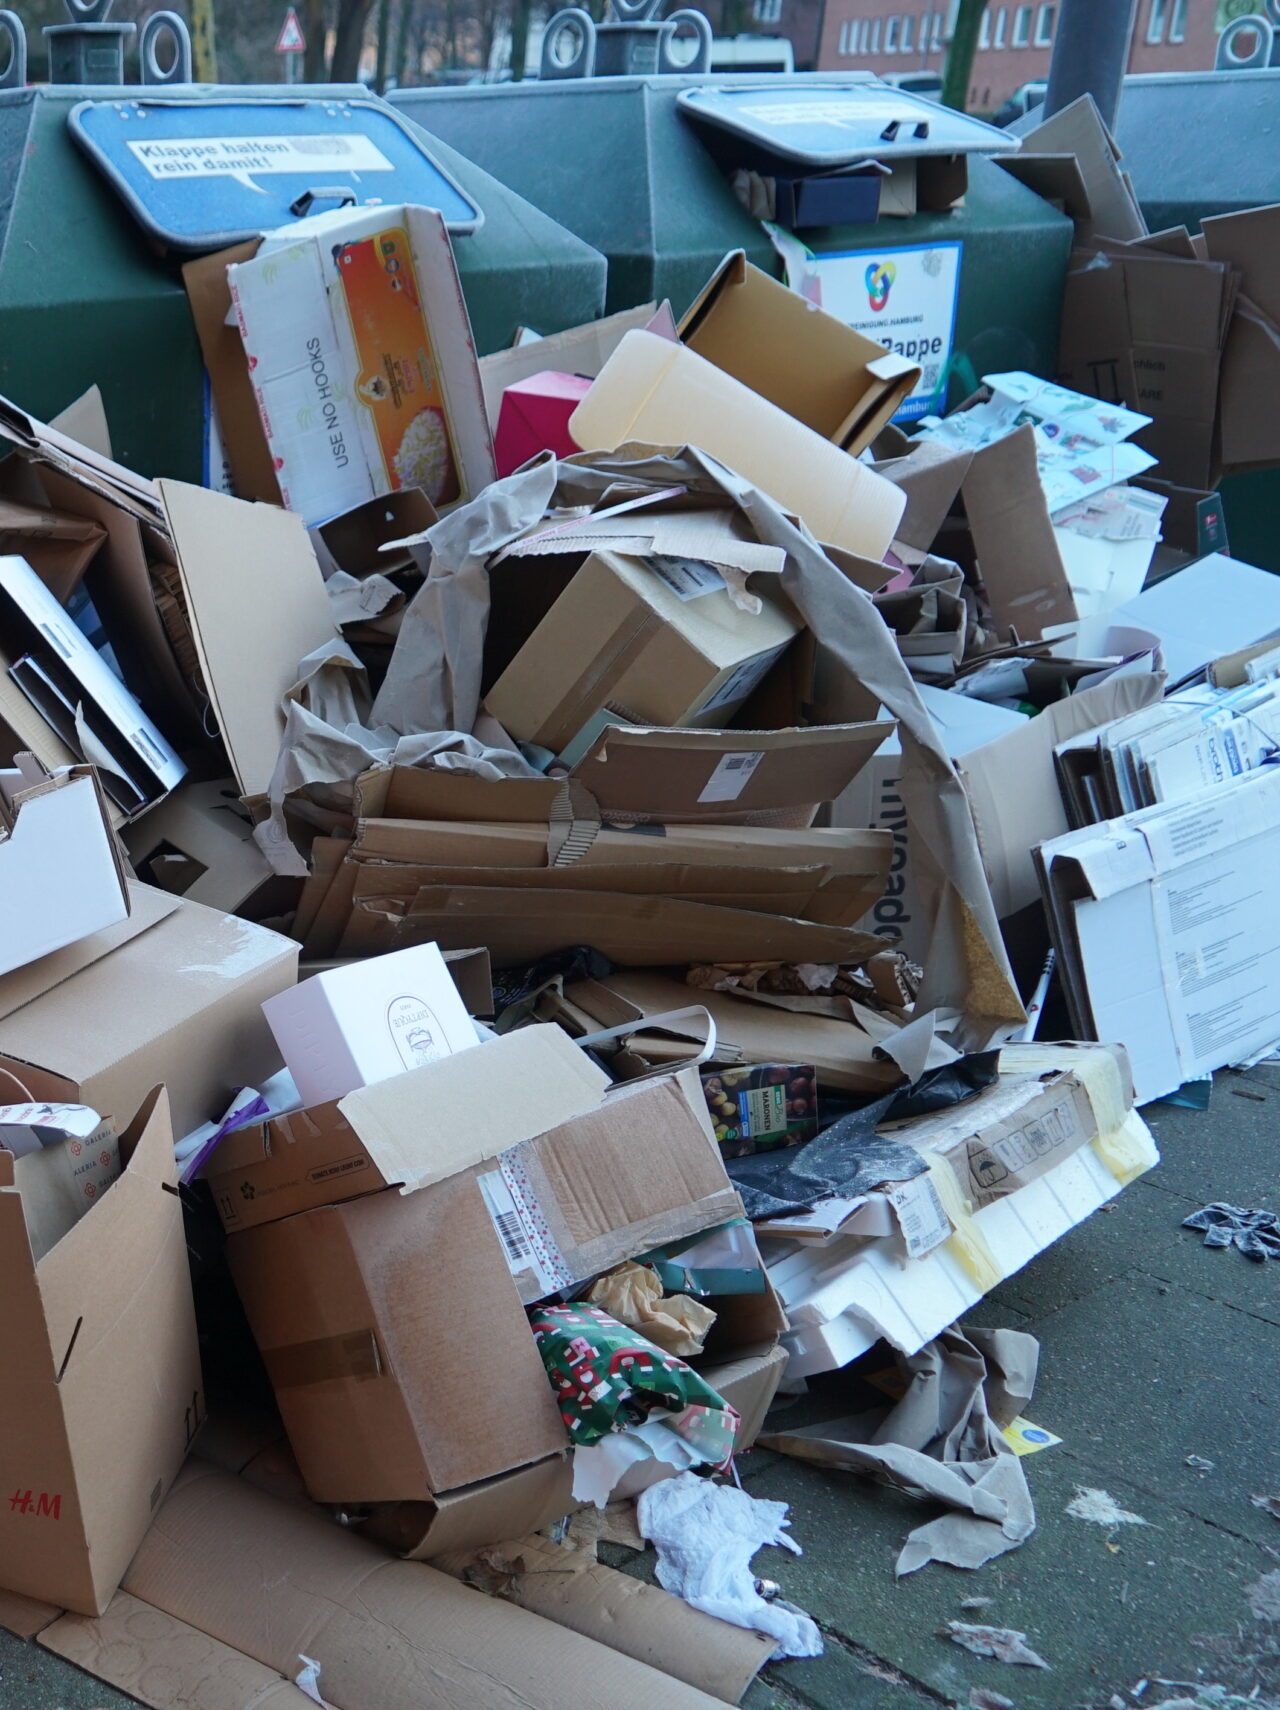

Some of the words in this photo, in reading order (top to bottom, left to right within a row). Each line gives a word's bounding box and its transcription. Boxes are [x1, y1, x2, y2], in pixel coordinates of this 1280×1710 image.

[138, 142, 217, 160] Klappe
[224, 141, 290, 155] halten
[153, 158, 197, 173] rein
[203, 156, 272, 170] damit!
[306, 337, 332, 400] HOOKS
[322, 402, 339, 430] NO
[330, 431, 349, 469] USE
[392, 1008, 429, 1028] DIPTYQUE
[762, 1090, 771, 1131] MARONEN
[74, 1161, 97, 1176] ALERIA
[8, 1489, 61, 1520] H&M
